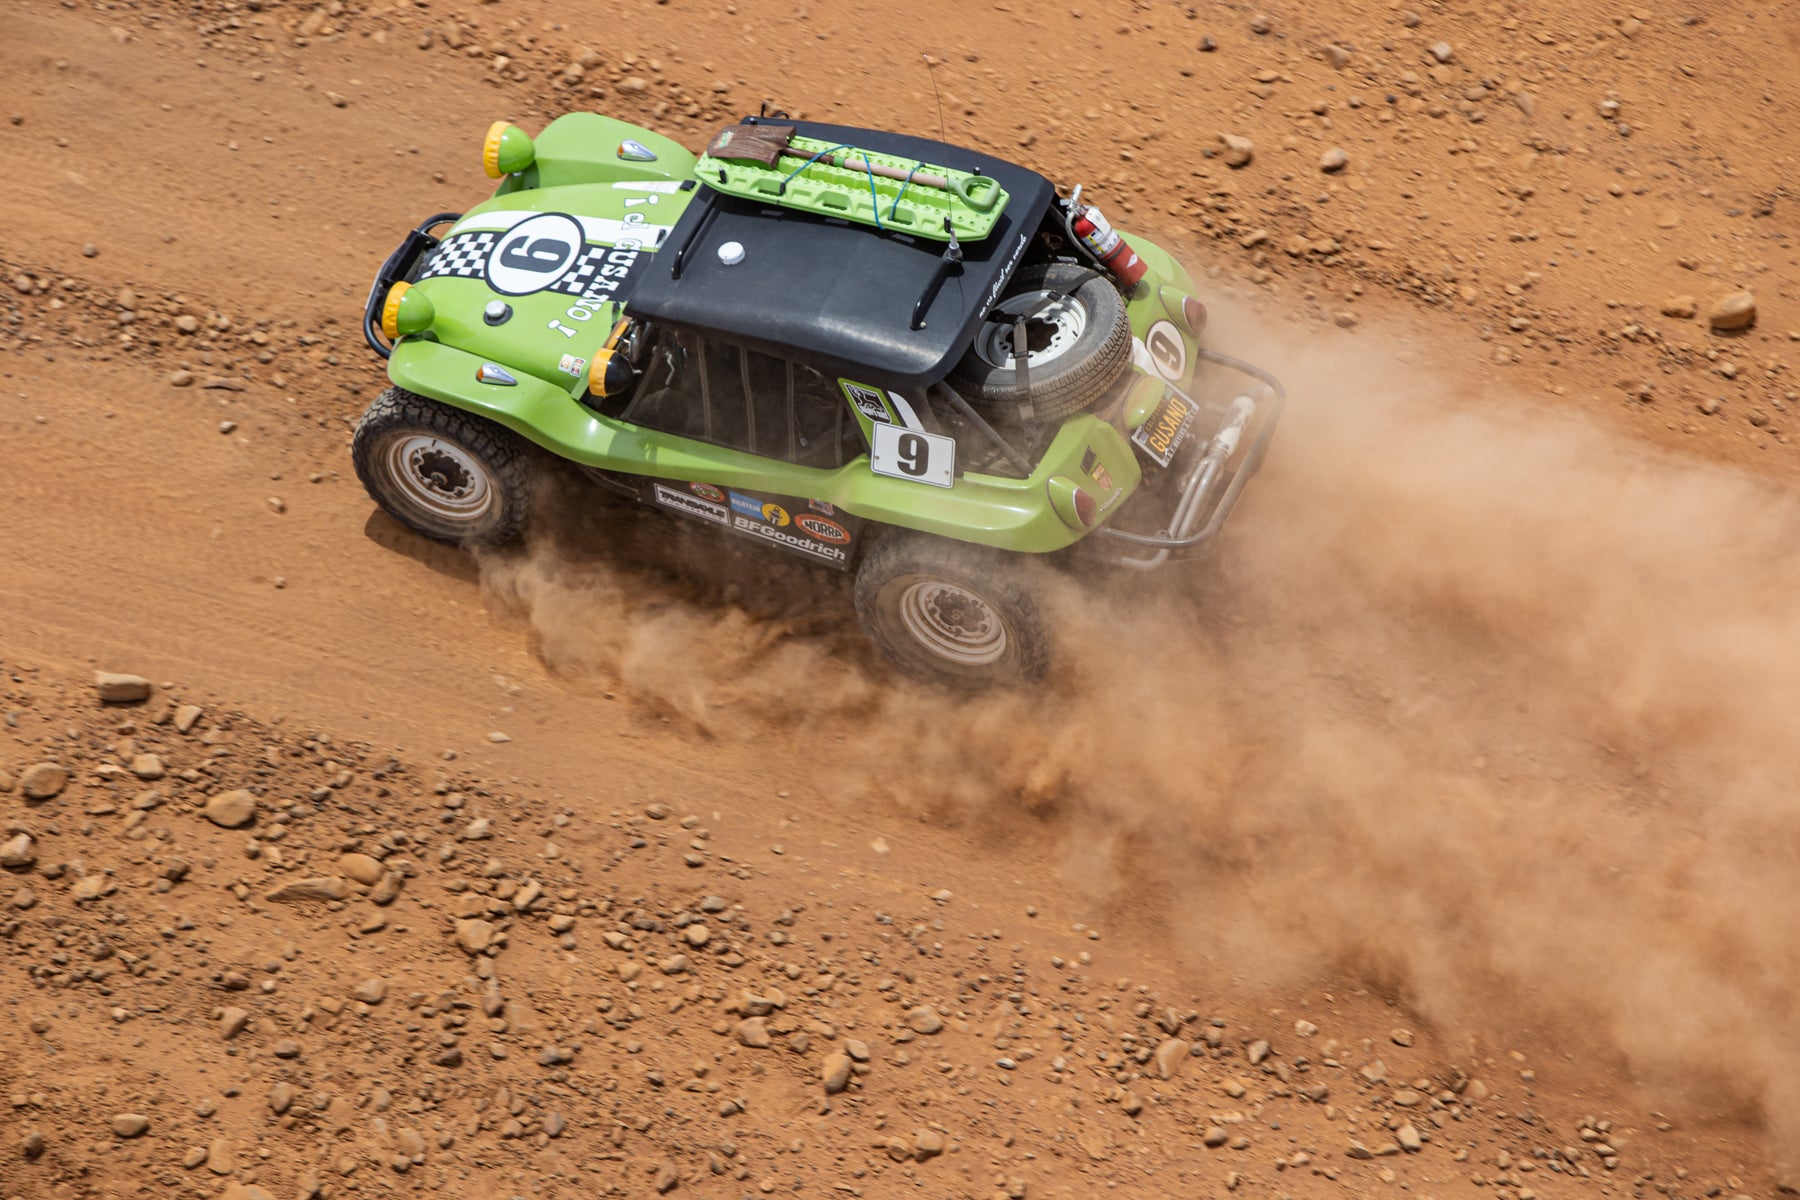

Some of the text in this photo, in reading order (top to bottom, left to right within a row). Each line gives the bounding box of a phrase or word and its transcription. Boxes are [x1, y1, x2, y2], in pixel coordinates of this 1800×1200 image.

[499, 234, 573, 274] 9
[1150, 330, 1182, 372] 9
[1150, 397, 1187, 453] GUSANO
[897, 433, 930, 477] 9
[734, 516, 846, 561] BFGoodrich
[804, 520, 844, 539] NORRA
